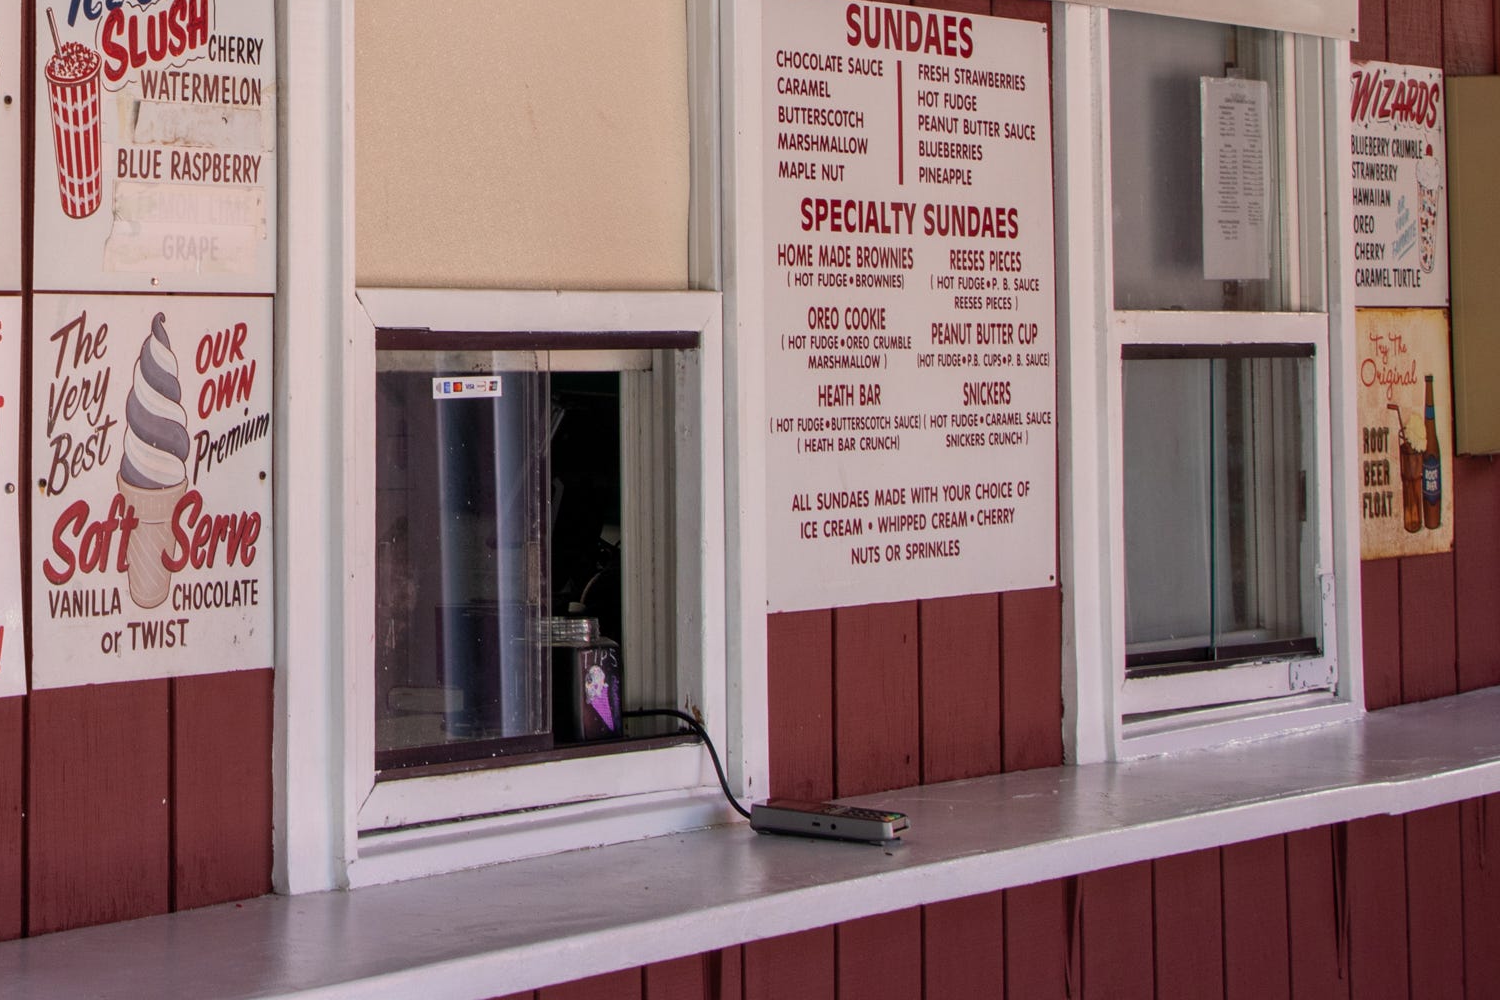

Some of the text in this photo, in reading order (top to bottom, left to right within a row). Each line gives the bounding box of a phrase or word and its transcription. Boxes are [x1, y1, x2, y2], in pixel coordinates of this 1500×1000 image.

[846, 3, 974, 59] SUNDAES
[207, 34, 265, 65] CHERRY
[776, 49, 884, 77] CHOCOLATE SAUCE
[139, 69, 262, 106] WATERMELON
[777, 76, 831, 99] CARAMEL
[917, 63, 1026, 92] FRESH STRAWBERRIES
[917, 90, 977, 112] HOT FUDGE
[1351, 69, 1439, 128] WIZARDS
[778, 105, 865, 129] BUTTERSCOTCH
[778, 132, 868, 155] MARSHMALLOW
[918, 140, 983, 161] BLUEBERRIES
[116, 148, 262, 184] BLUE RASPBERRY
[918, 166, 973, 186] PINEAPPLE
[1351, 161, 1398, 183] STRAWBERRY
[1352, 187, 1391, 208] HAWAIIAN
[800, 197, 1020, 240] SPECIALTY SUNDAES
[1353, 214, 1375, 235] OREO
[778, 243, 914, 270] HOME MADE BROWNIES
[1354, 242, 1385, 262] CHERRY
[1355, 268, 1421, 289] CARAMEL TURTLE
[807, 306, 886, 330] OREO COOKIE
[963, 381, 1011, 406] SNICKERS
[192, 406, 270, 485] Premium
[1362, 426, 1390, 455] ROOT
[1363, 458, 1391, 488] BEER
[1362, 491, 1394, 520] FLOAT
[42, 490, 262, 585] Soft Serve
[851, 539, 961, 565] NUTS OR SPRINKLES
[581, 647, 619, 668] TIPS
